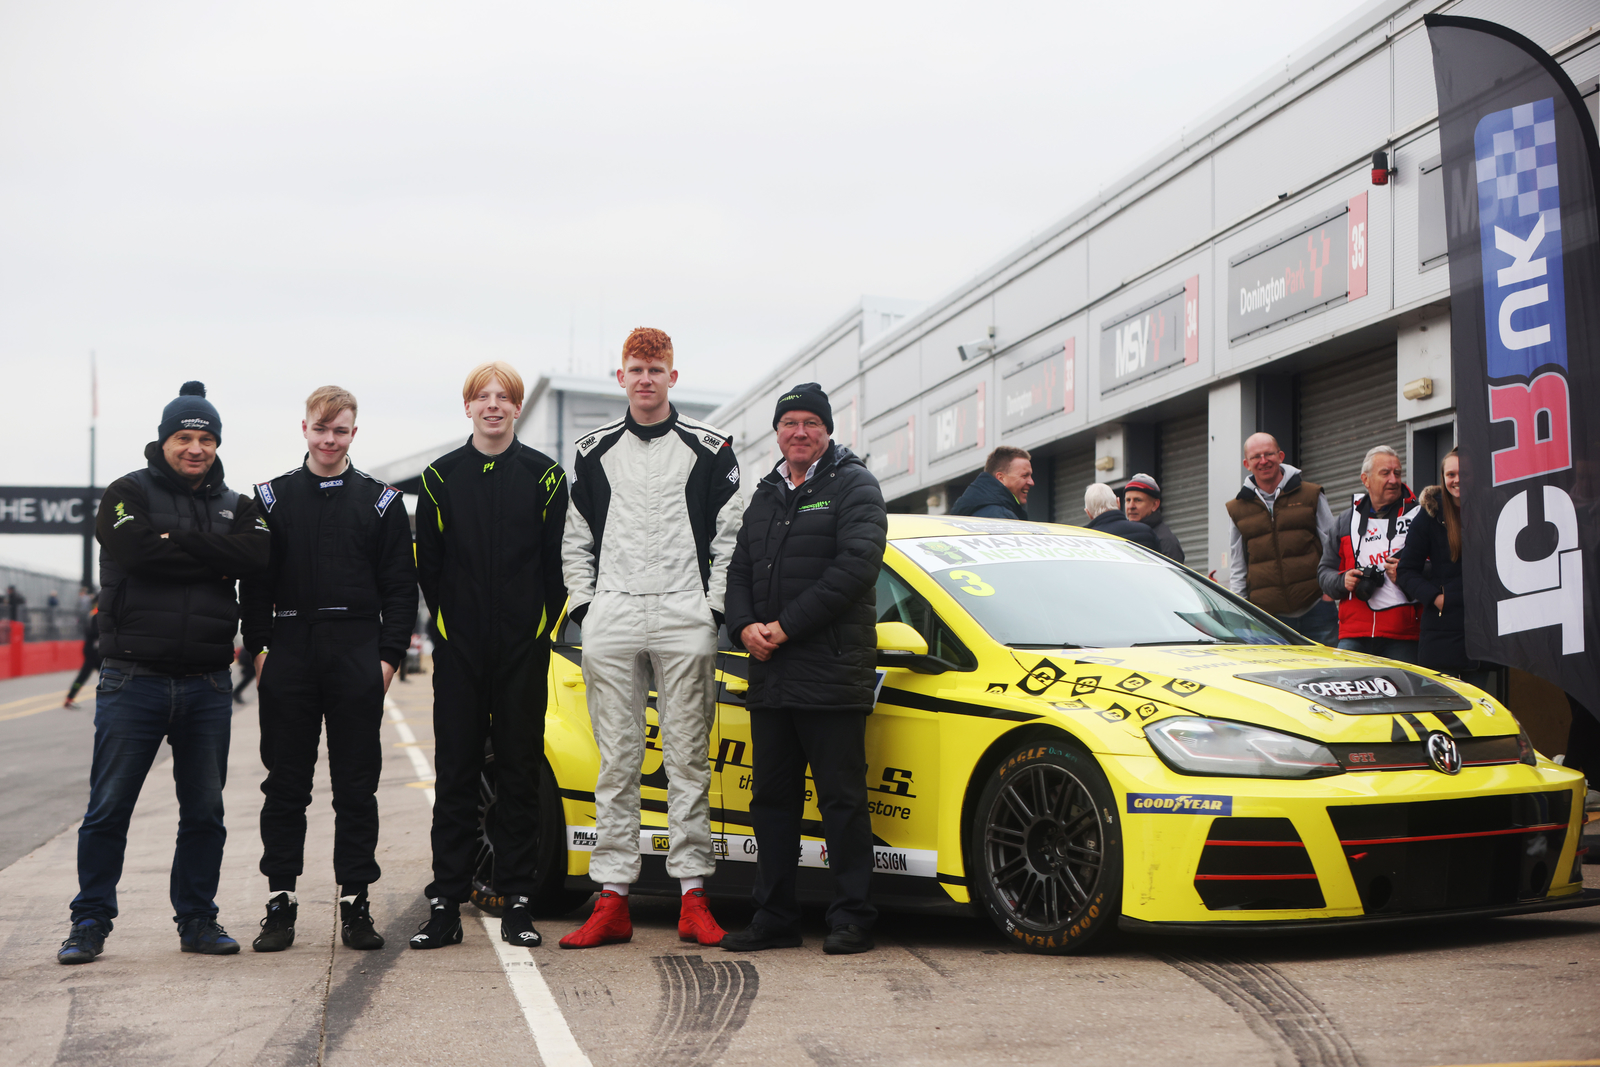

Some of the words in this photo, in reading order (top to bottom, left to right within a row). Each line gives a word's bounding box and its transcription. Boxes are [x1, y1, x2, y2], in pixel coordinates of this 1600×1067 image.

[1351, 222, 1365, 270] 35
[1240, 276, 1286, 316] Donington
[1285, 260, 1306, 296] Park
[1494, 213, 1551, 351] UK
[1187, 298, 1197, 338] 34
[1115, 314, 1150, 378] MSV
[581, 436, 597, 450] OMP
[703, 435, 721, 447] OMP
[483, 461, 495, 473] P1
[728, 467, 740, 483] OMP
[1487, 371, 1585, 656] TCR
[958, 536, 1106, 550] MAXIMUM
[978, 548, 1122, 561] NETWORKS
[949, 570, 996, 597] 3
[1298, 680, 1379, 697] CORBEAU
[999, 746, 1048, 780] EAGLE
[1348, 752, 1376, 763] GTI
[867, 800, 911, 820] store
[1133, 795, 1223, 812] GOODYEAR
